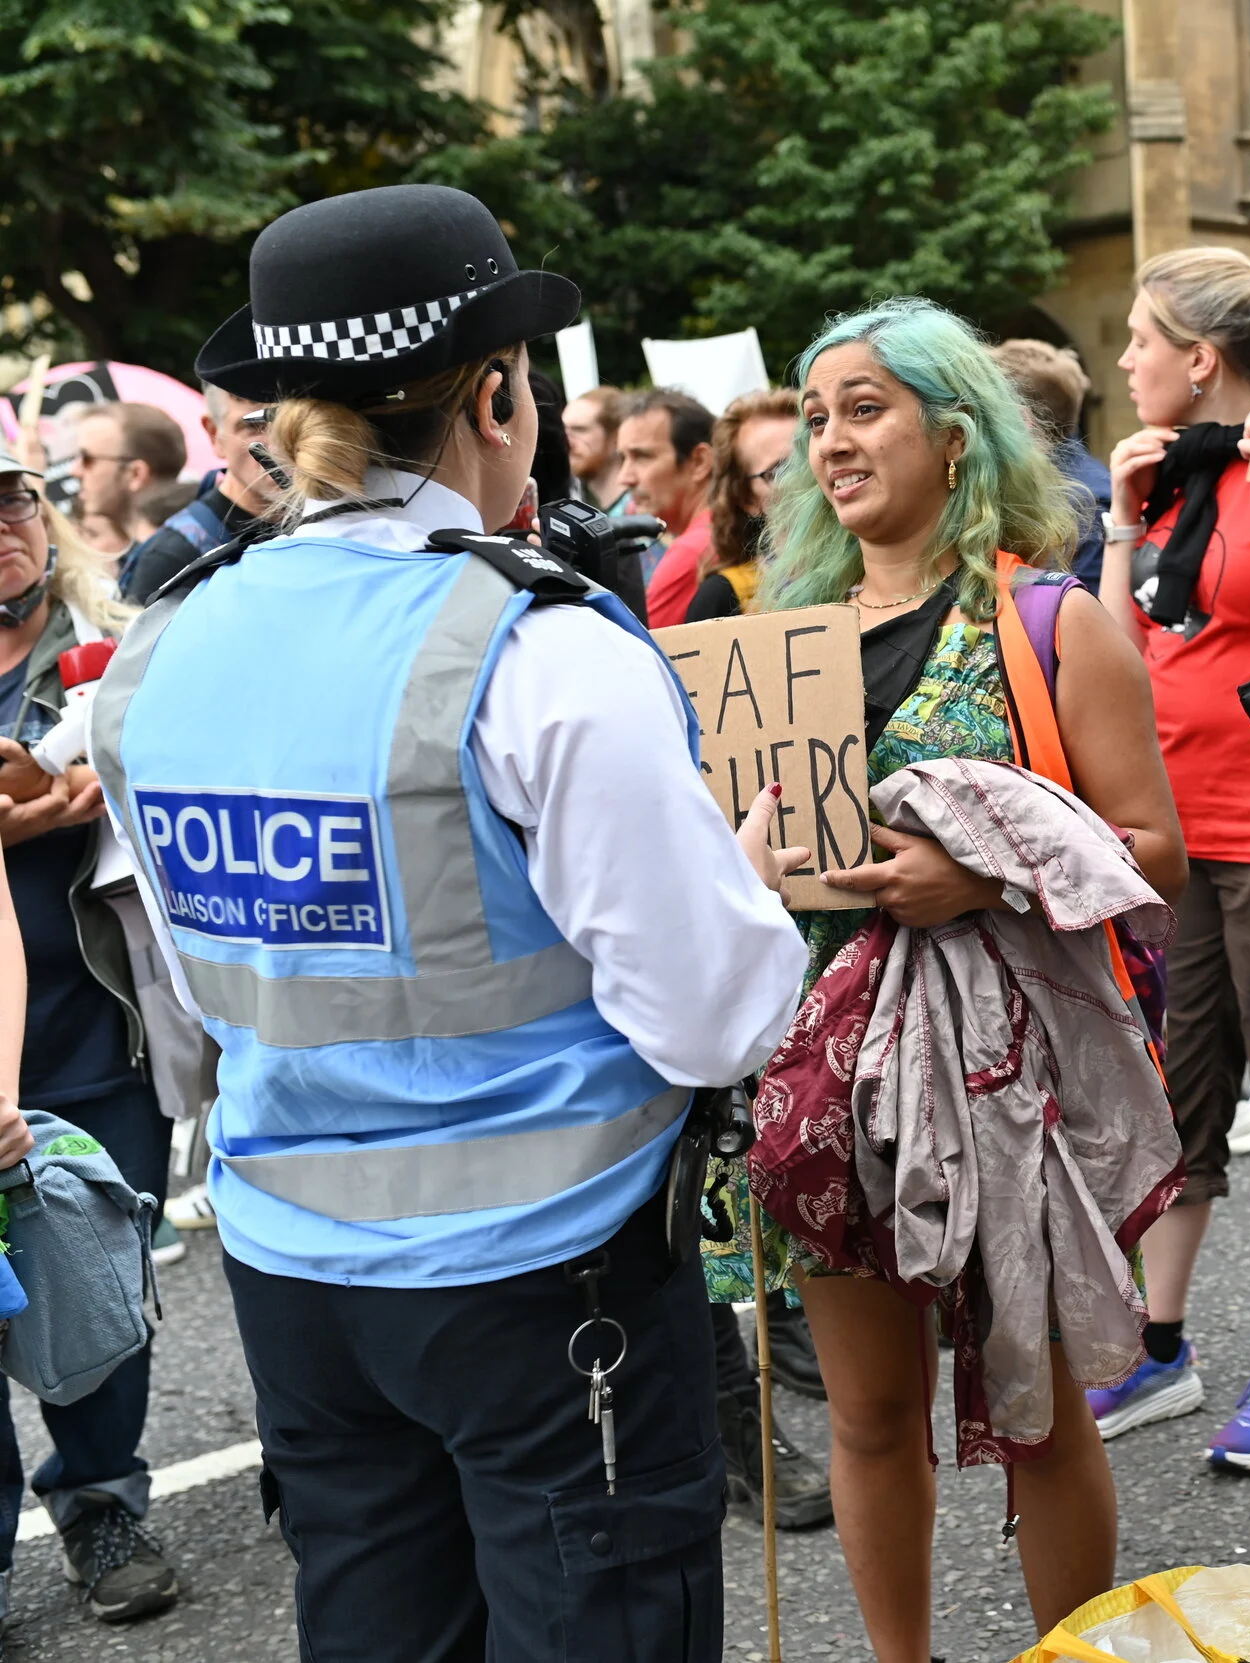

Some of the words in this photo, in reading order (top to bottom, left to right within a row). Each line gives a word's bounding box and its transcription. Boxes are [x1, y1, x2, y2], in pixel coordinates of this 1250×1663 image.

[141, 804, 370, 883] POLICE
[700, 734, 869, 877] HERS
[164, 886, 247, 926] LIAISON
[253, 897, 378, 933] OFICER
